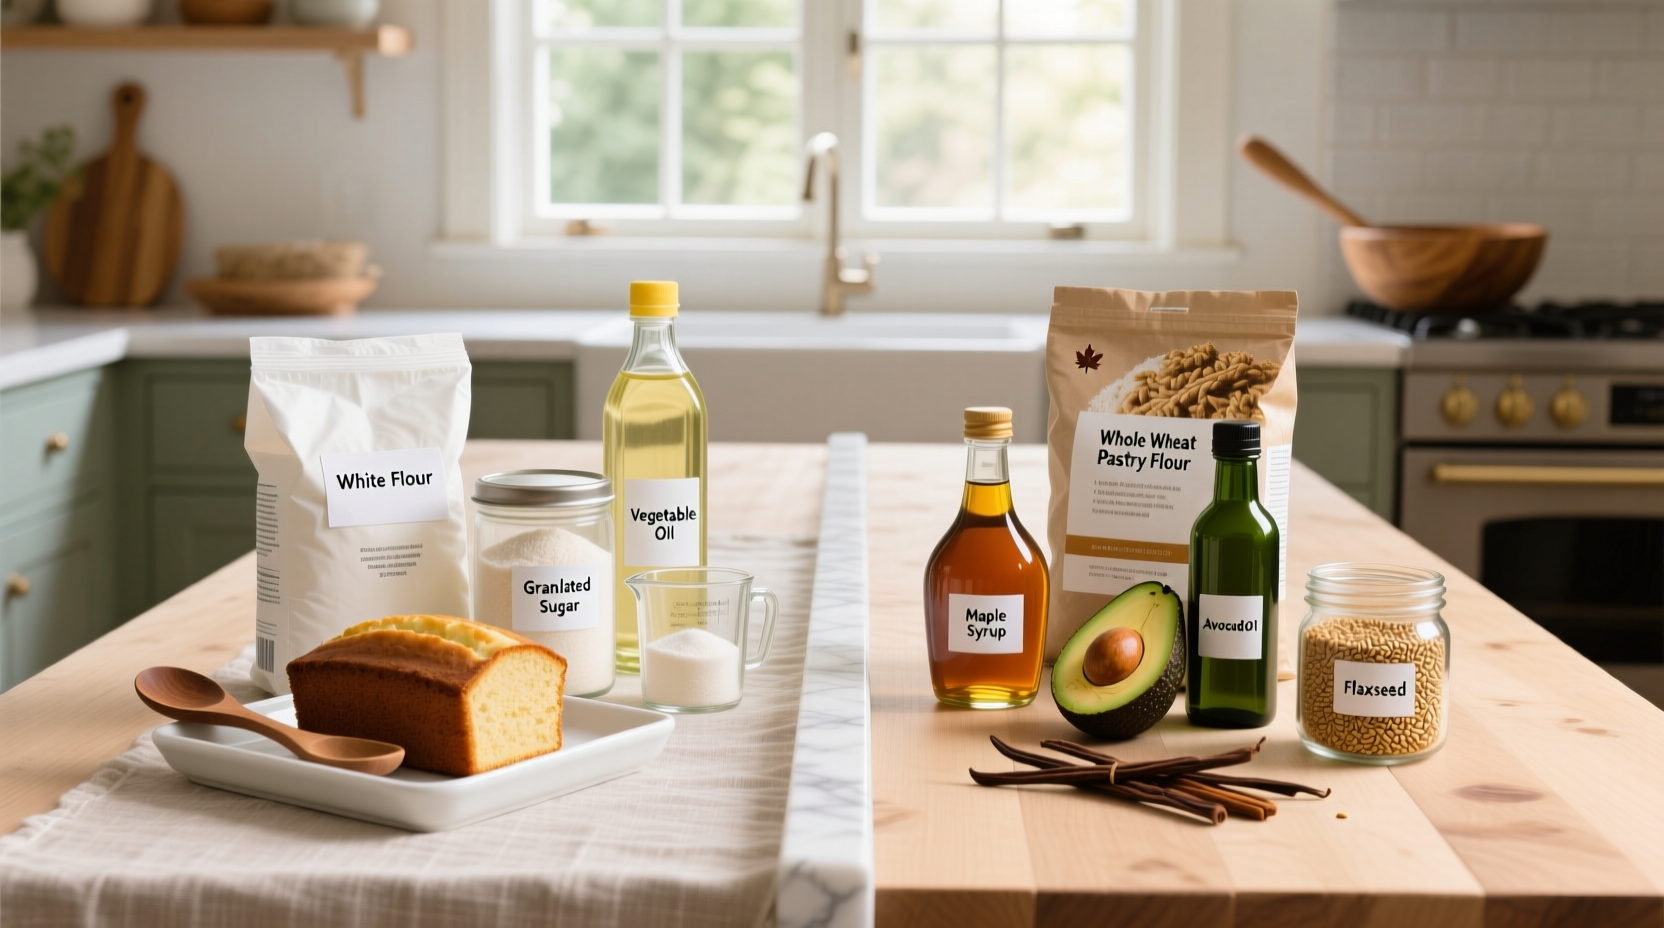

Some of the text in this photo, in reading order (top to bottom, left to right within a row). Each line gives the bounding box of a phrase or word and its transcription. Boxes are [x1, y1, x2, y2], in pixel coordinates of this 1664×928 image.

[1099, 428, 1198, 450] Whole Wheat
[1096, 448, 1192, 473] Pastry Flour
[336, 470, 433, 490] White Flour
[630, 505, 697, 526] Vegetable
[523, 576, 591, 595] Granlated
[539, 599, 580, 617] Sugar
[965, 607, 1007, 626] Maple
[967, 624, 1007, 642] Syrup
[1344, 679, 1407, 697] Flaxseed
